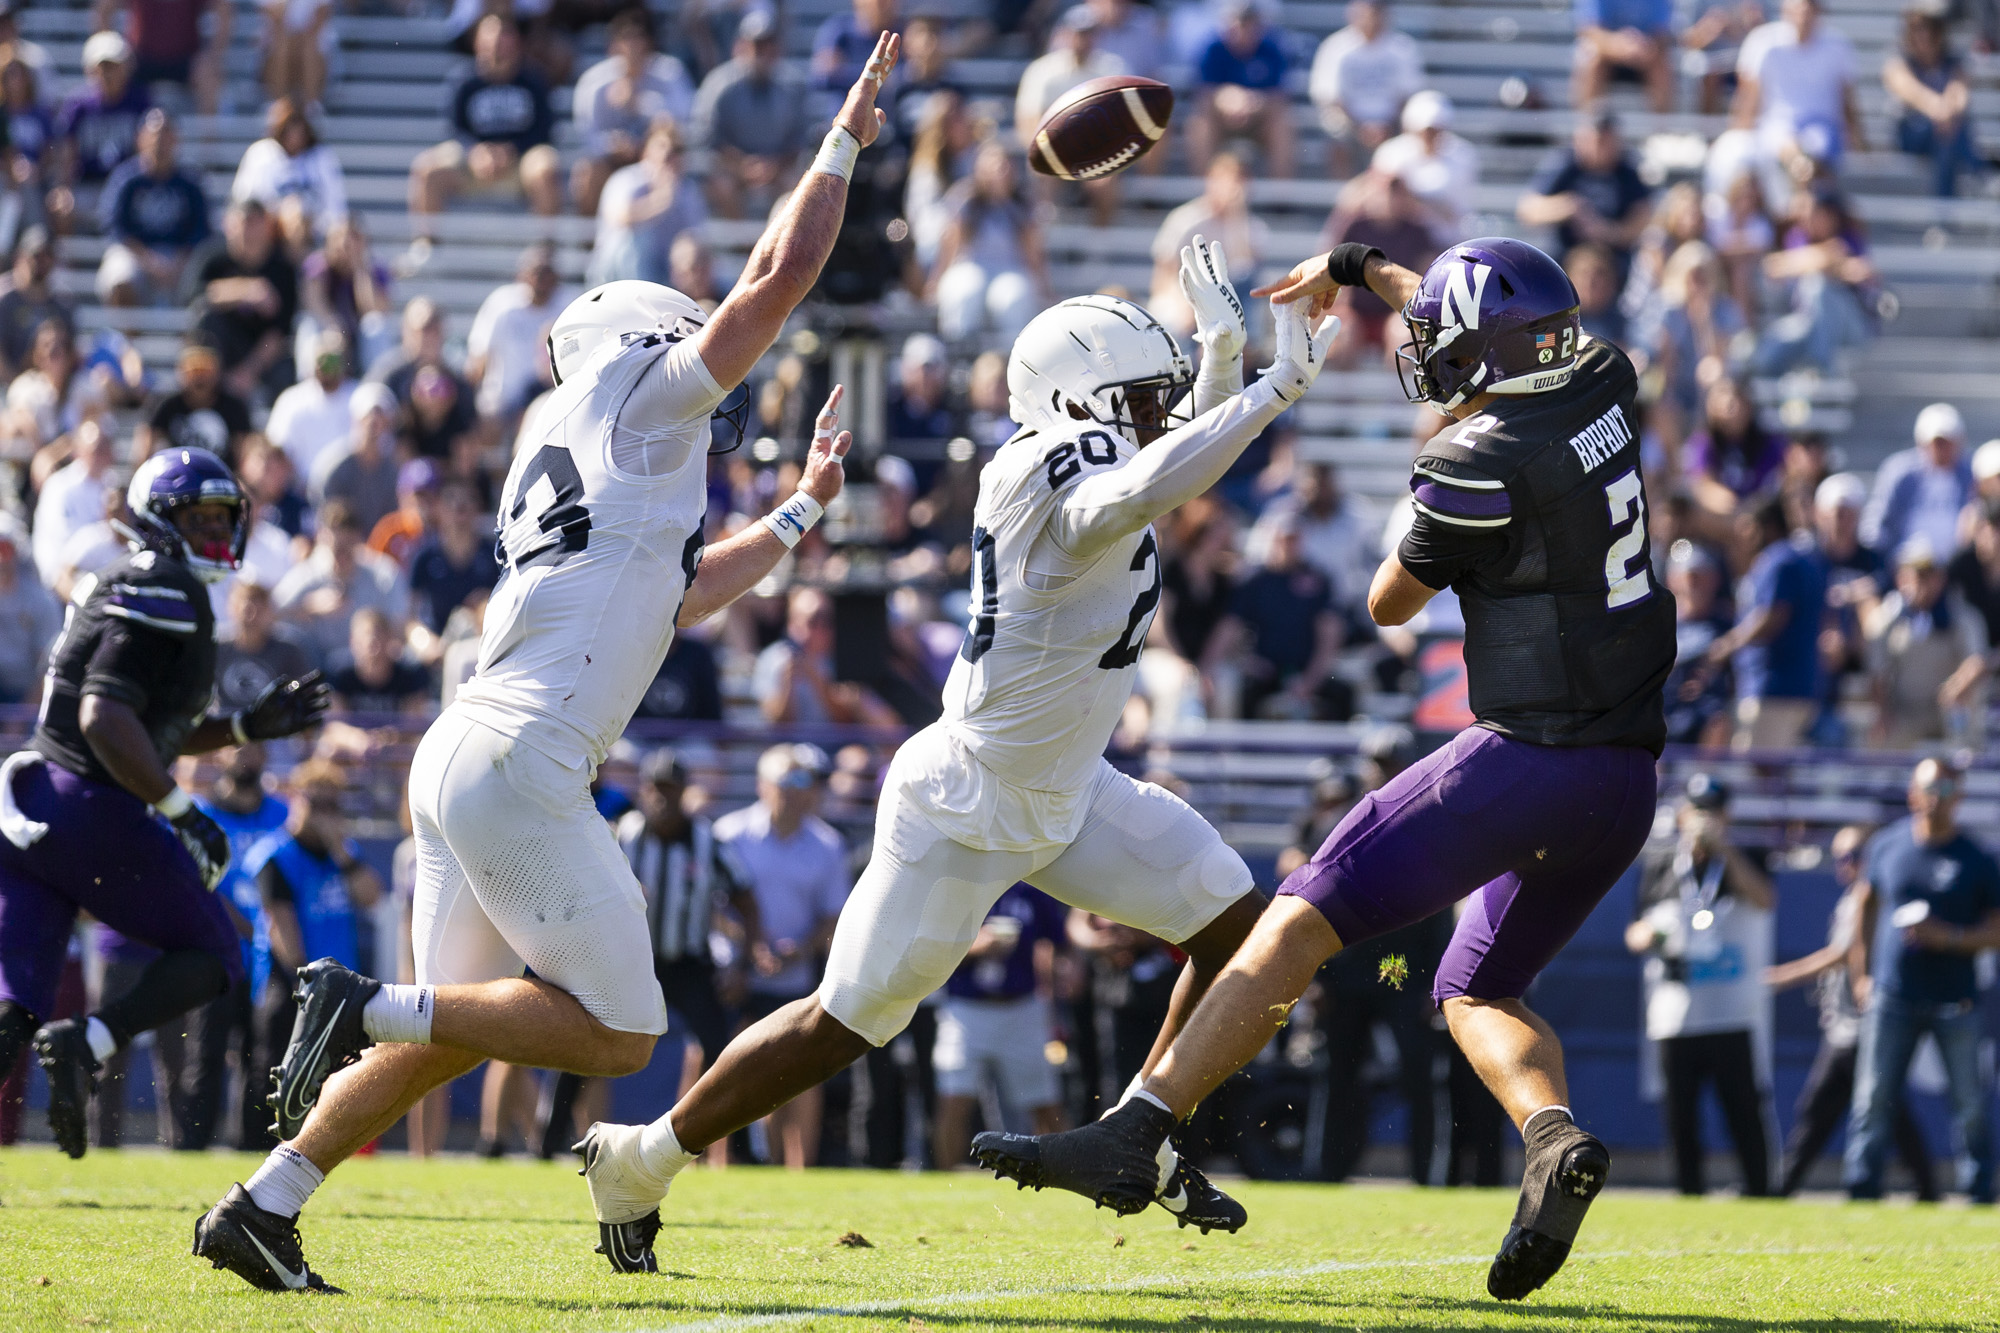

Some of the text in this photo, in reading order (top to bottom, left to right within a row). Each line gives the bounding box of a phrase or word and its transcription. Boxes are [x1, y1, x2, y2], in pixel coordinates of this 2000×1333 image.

[1441, 262, 1492, 330] N
[1561, 326, 1573, 359] 2
[1044, 429, 1119, 491] 20
[1450, 413, 1499, 449] 2
[1568, 403, 1633, 474] BRYANT
[1601, 465, 1652, 613] 2
